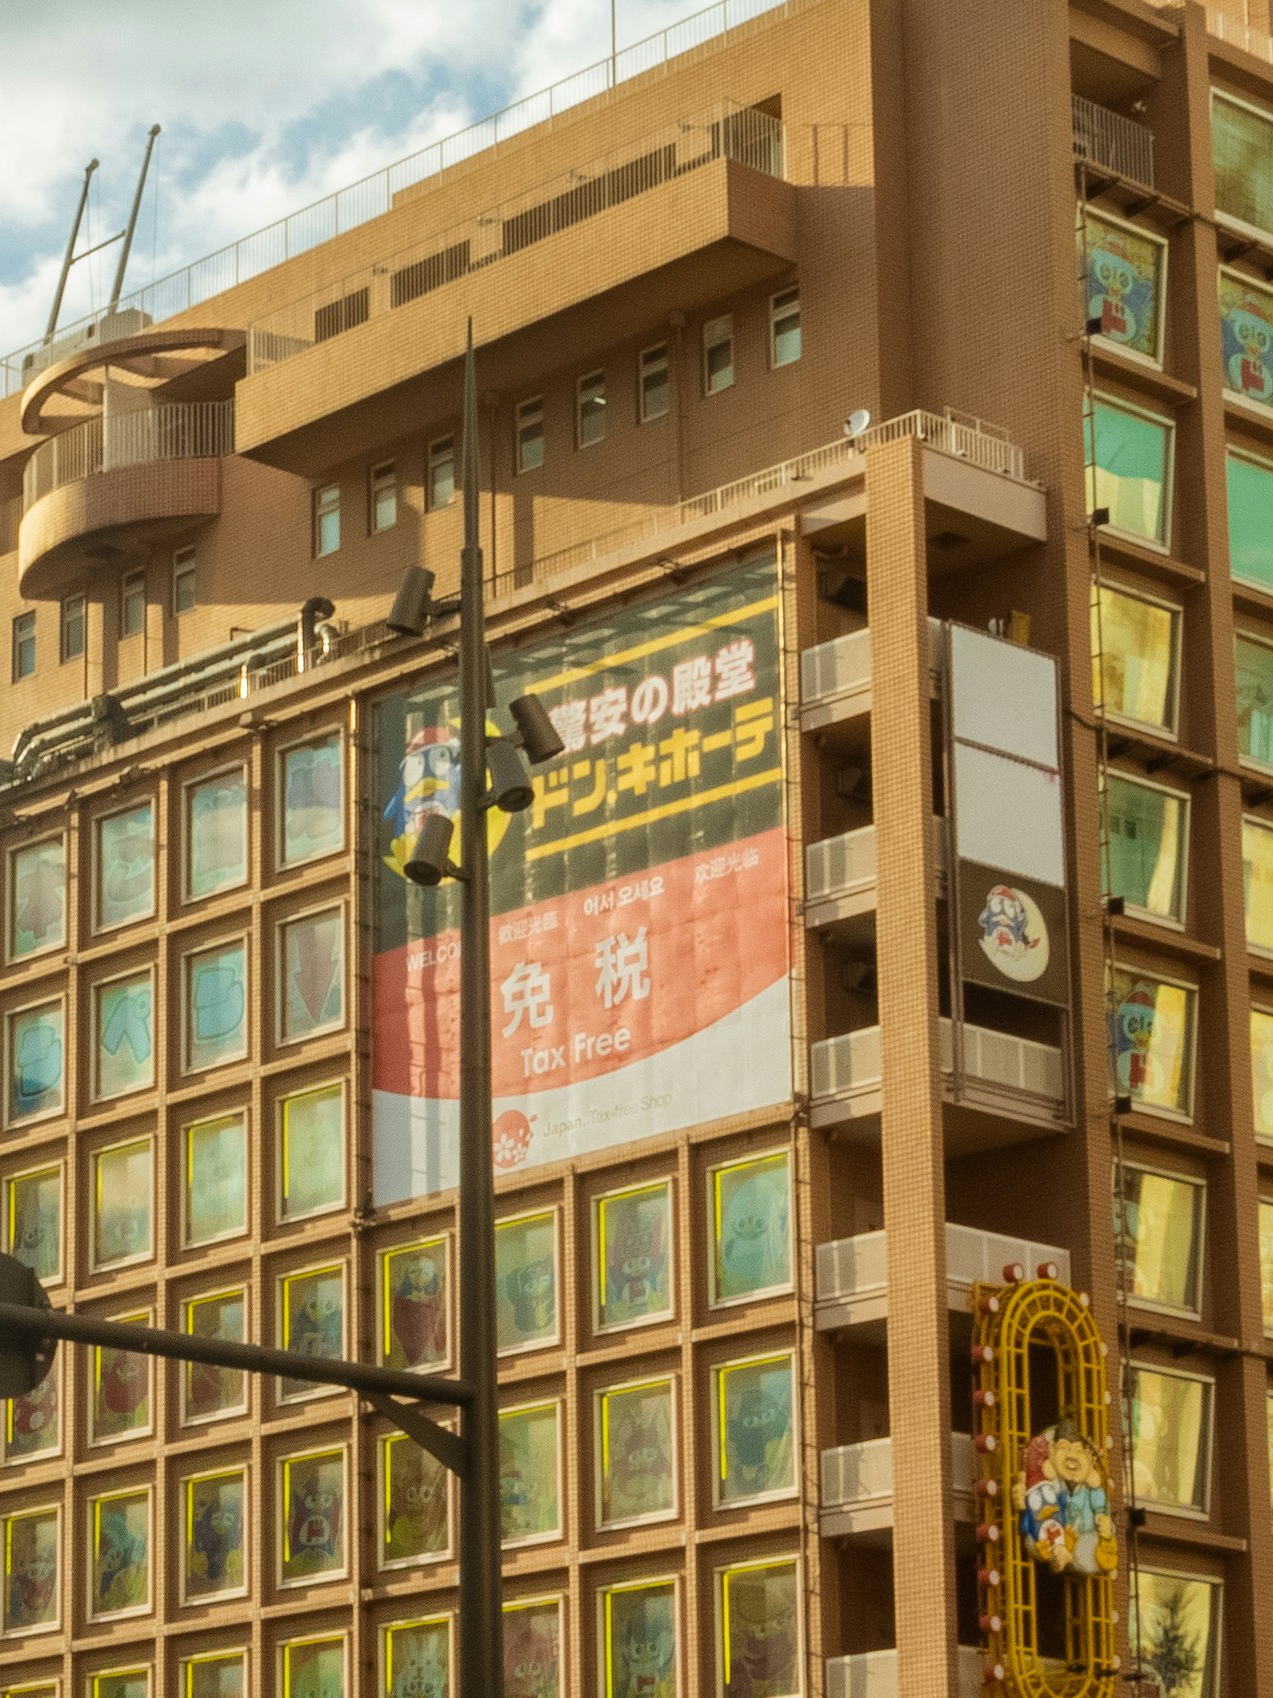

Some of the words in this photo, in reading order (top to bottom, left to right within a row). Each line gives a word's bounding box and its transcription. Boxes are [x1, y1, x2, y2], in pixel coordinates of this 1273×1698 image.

[548, 639, 756, 758] 驚安の殿堂
[616, 875, 665, 909] 오세요
[500, 926, 652, 1038] 免税
[521, 1045, 566, 1078] Tax
[574, 1026, 631, 1063] Free
[641, 1093, 673, 1111] Shop
